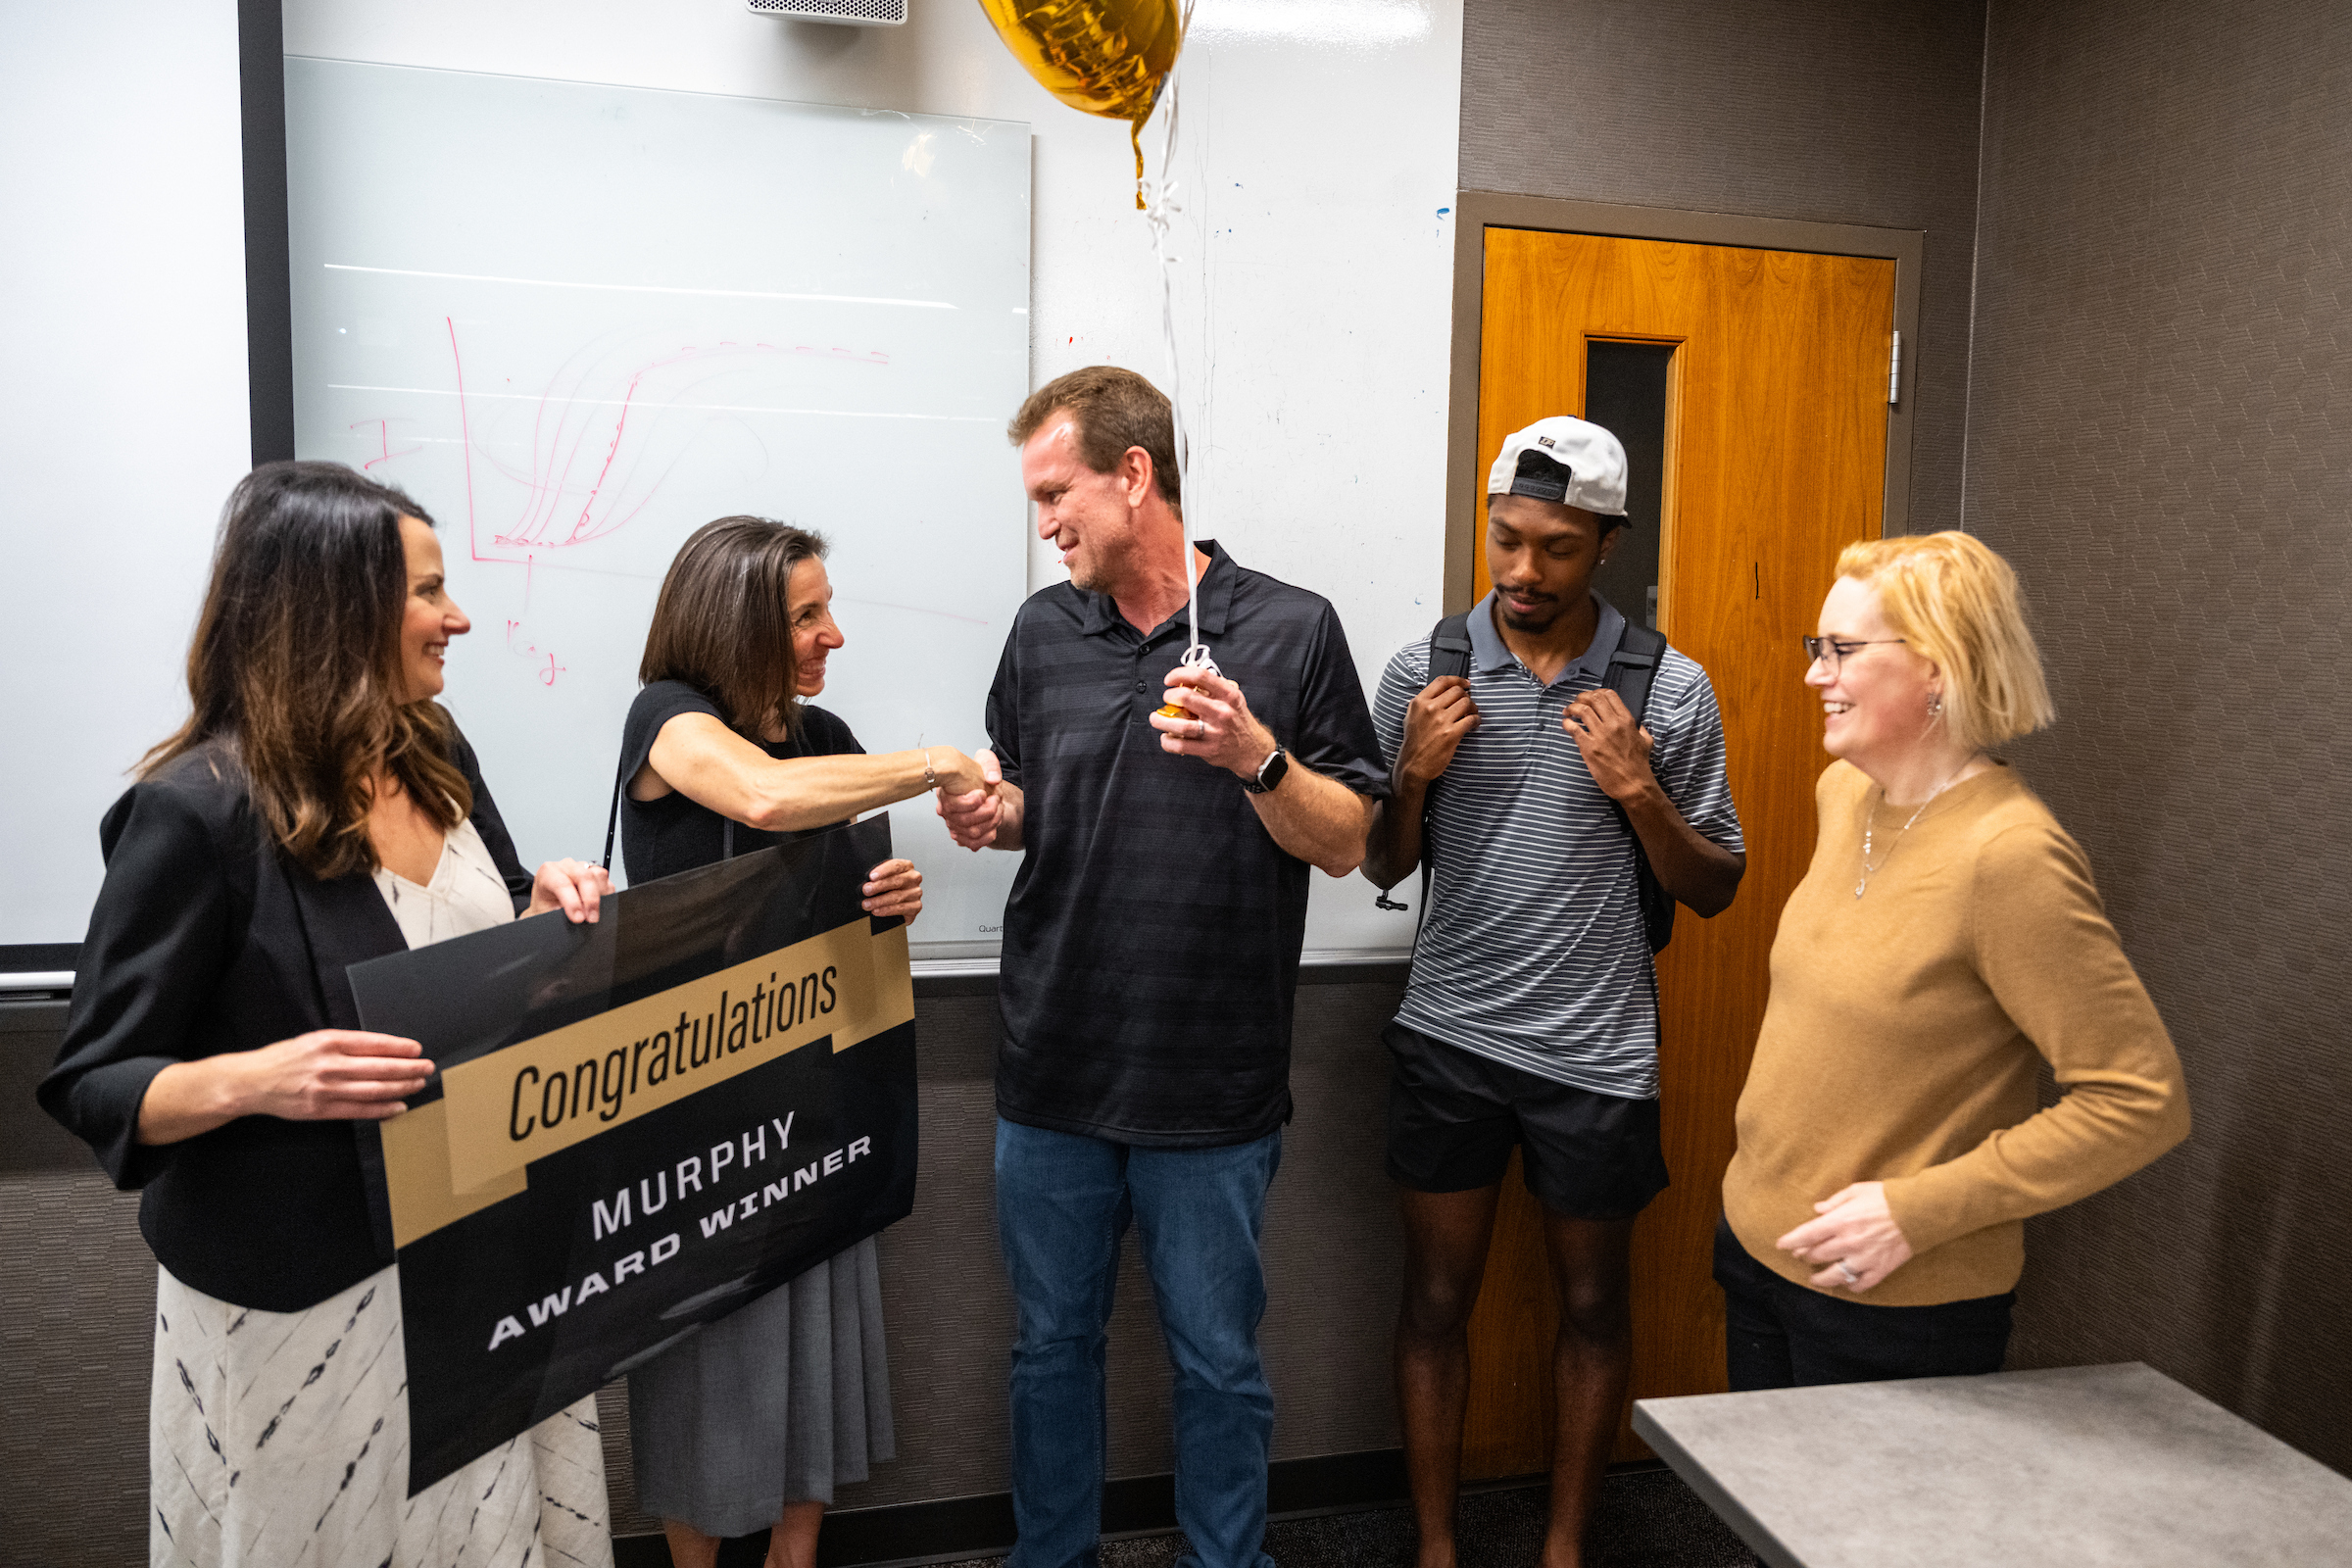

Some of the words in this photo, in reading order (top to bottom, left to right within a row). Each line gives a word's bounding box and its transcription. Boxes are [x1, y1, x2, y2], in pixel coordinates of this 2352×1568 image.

[510, 965, 837, 1142] Congratulations
[488, 1233, 681, 1350] AWARD
[700, 1135, 871, 1239] WINNER
[592, 1111, 795, 1241] MURPHY
